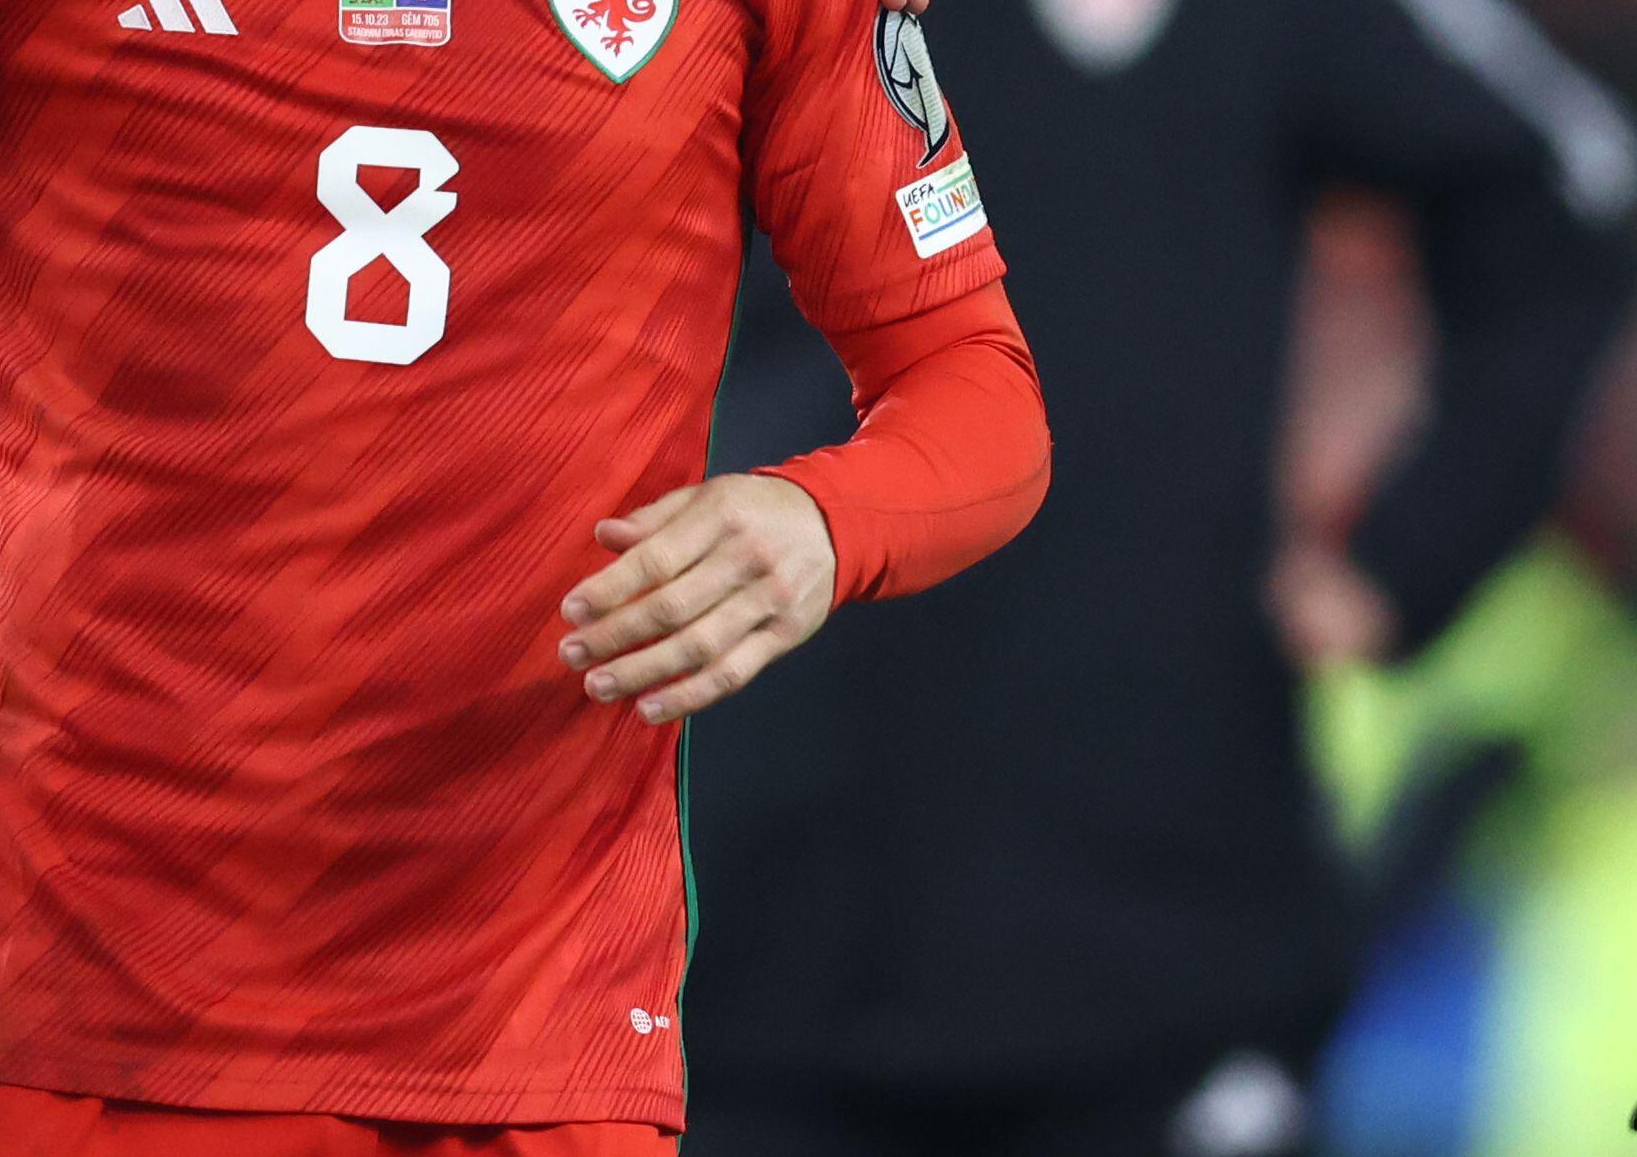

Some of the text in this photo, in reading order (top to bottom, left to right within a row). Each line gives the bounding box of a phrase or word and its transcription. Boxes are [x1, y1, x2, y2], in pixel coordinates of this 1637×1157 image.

[351, 13, 389, 26] 15.10.23
[423, 14, 440, 27] 705
[903, 183, 936, 208] UEFA
[305, 125, 460, 366] 8
